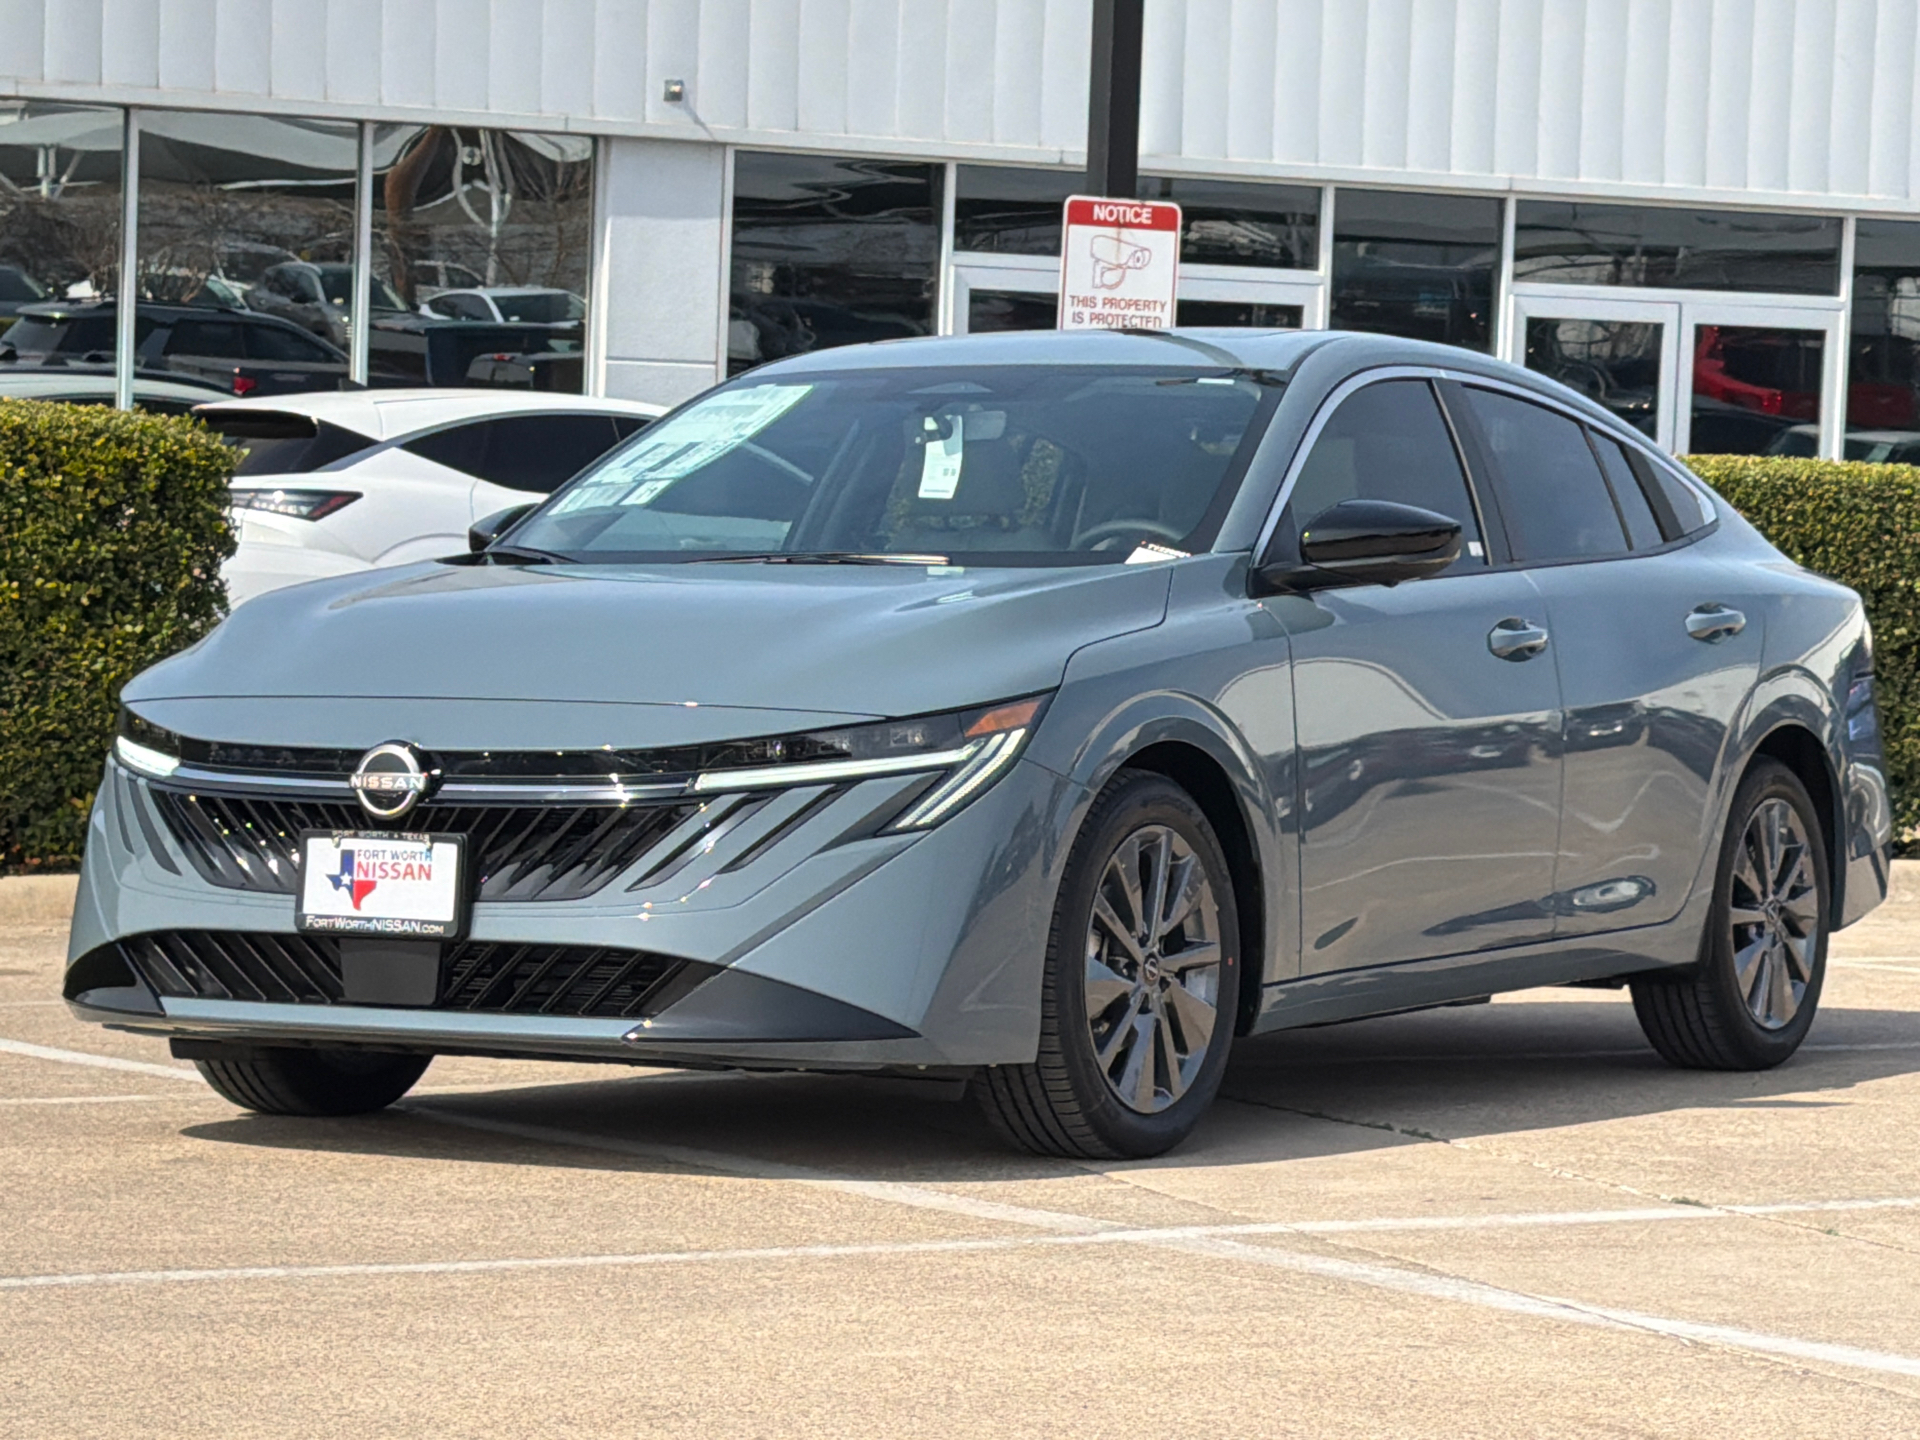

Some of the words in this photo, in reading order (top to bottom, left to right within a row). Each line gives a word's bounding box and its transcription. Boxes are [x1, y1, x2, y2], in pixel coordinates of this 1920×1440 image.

[1093, 204, 1152, 224] NOTICE
[1069, 295, 1097, 309] THIS
[1102, 297, 1167, 312] PROPERTY
[1072, 311, 1084, 324] IS
[1089, 312, 1162, 328] PROTECTED
[351, 775, 424, 789] NISSAN
[357, 849, 386, 860] FORT
[390, 849, 433, 862] WORTH
[356, 862, 433, 881] NISSAN
